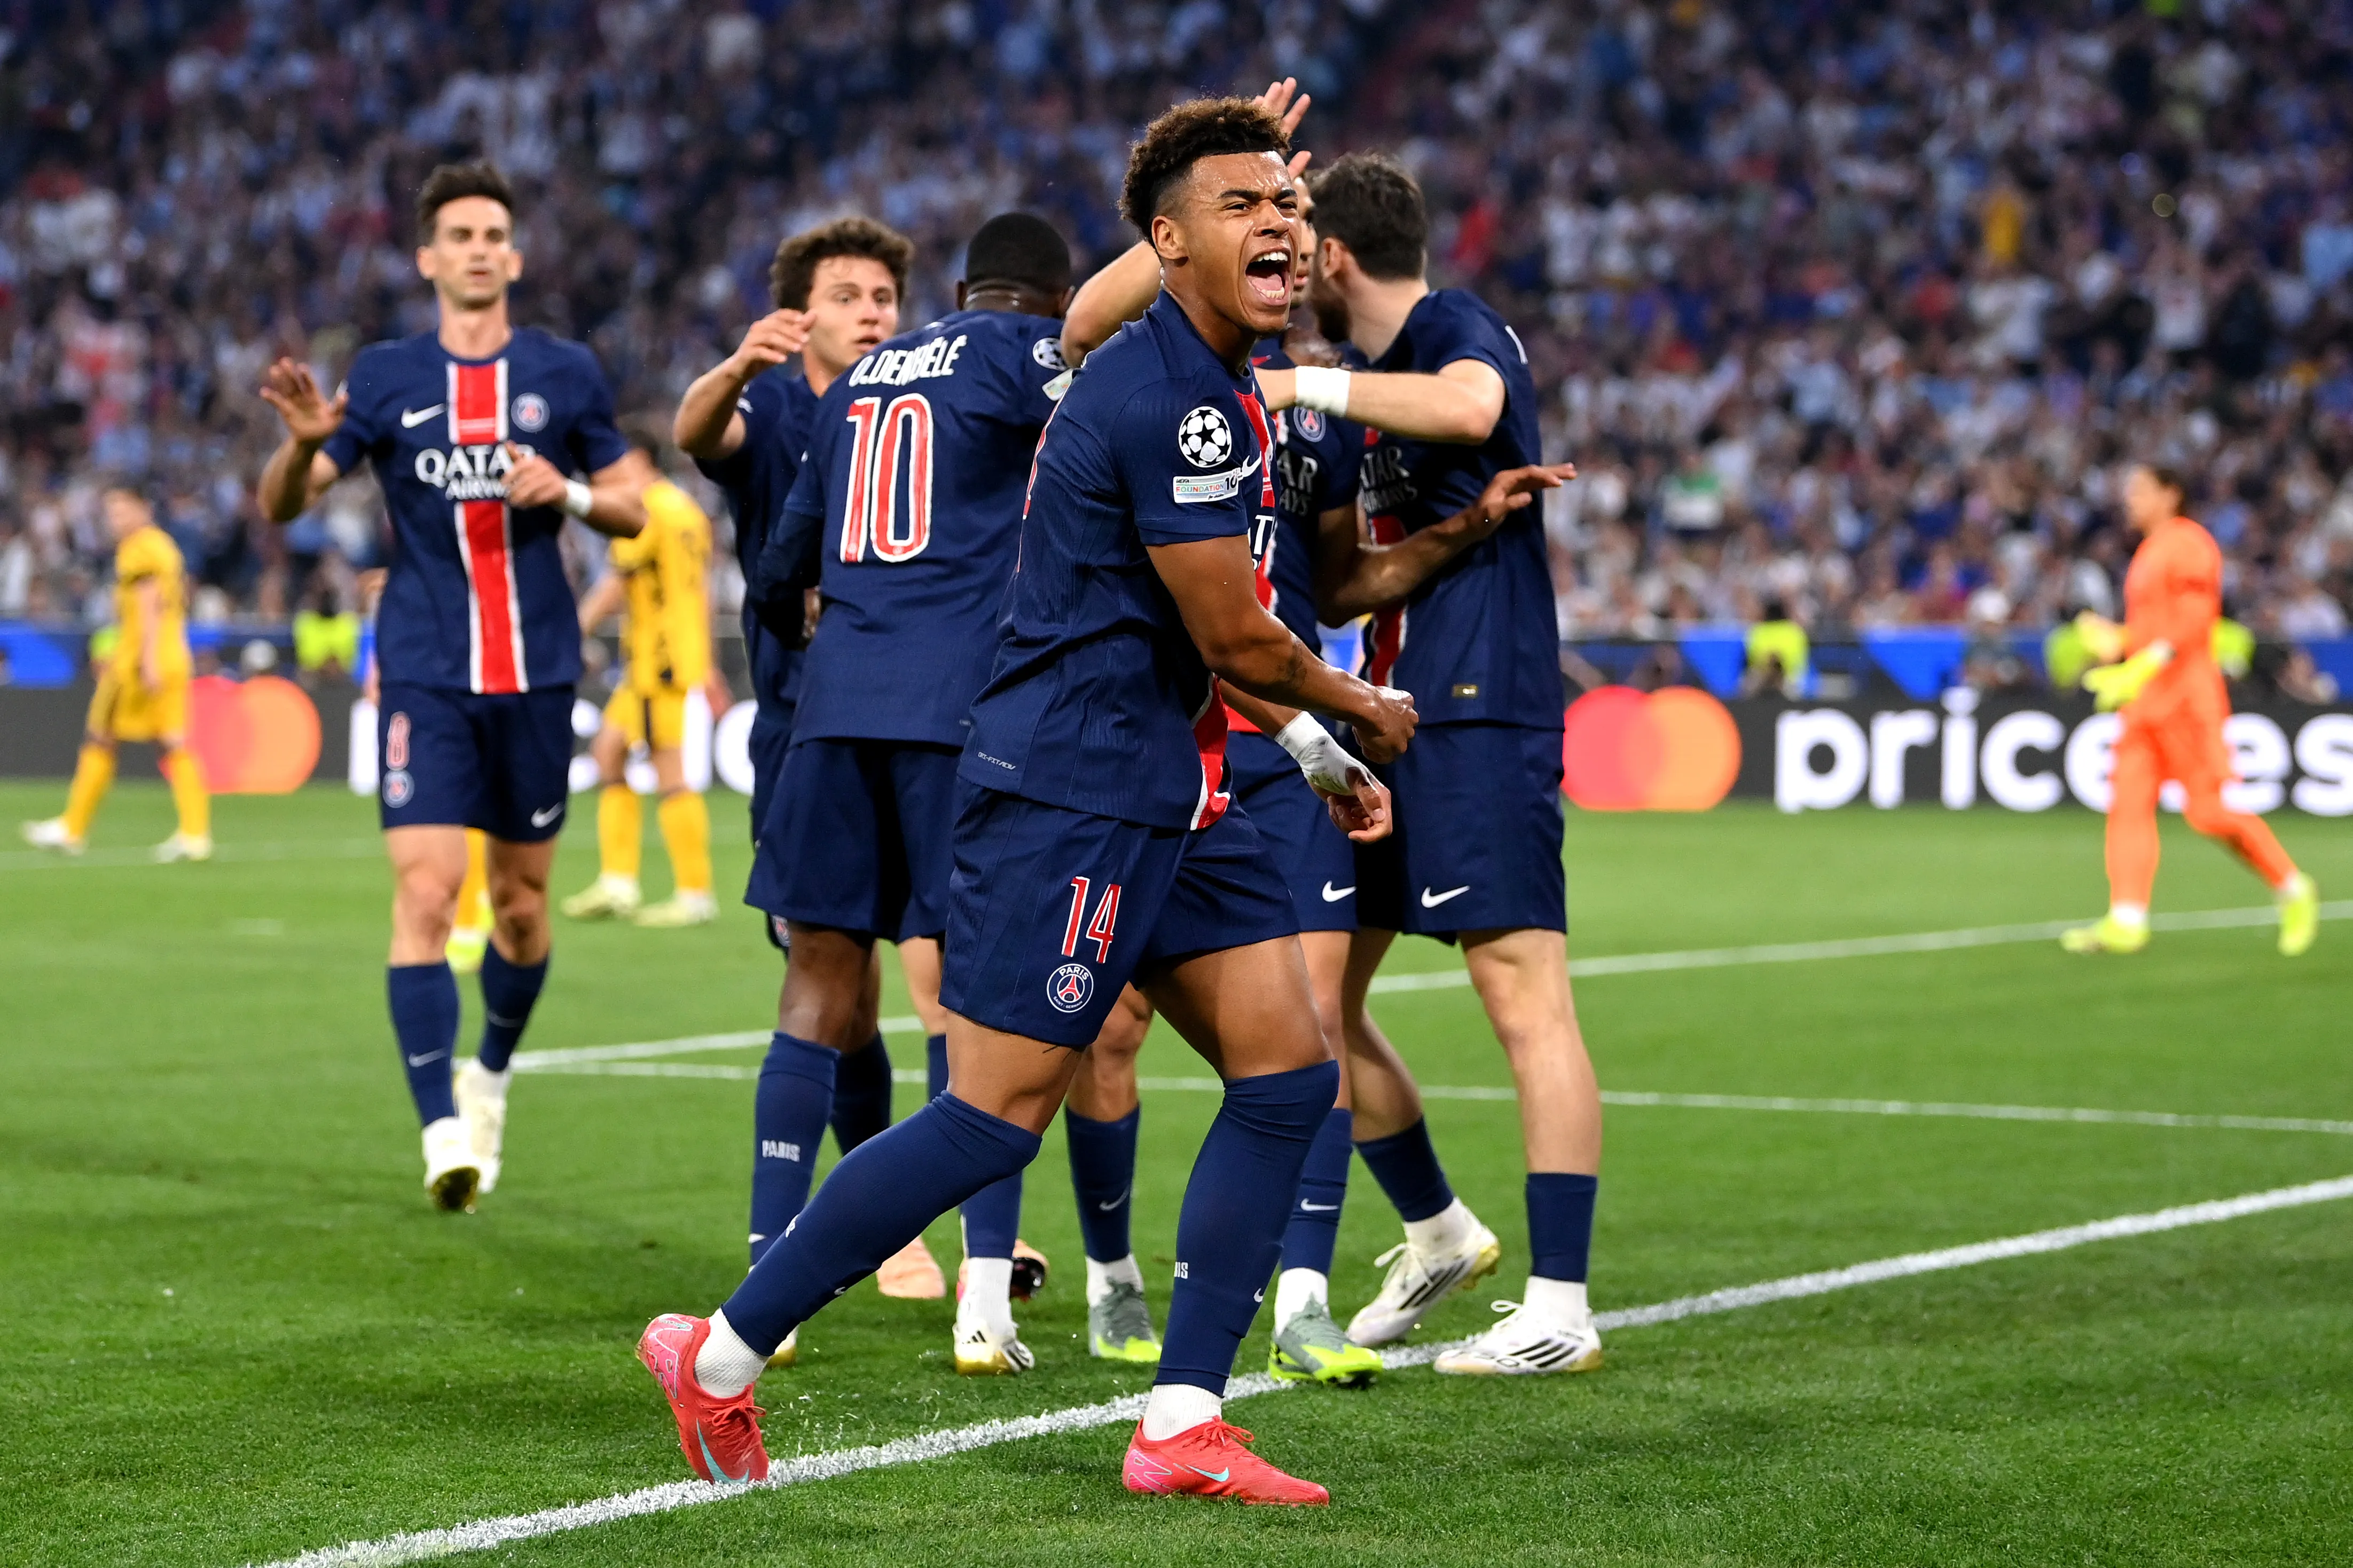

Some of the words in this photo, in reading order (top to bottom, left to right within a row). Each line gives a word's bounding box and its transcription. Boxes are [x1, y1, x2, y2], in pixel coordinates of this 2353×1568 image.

[414, 443, 536, 488] QATA
[840, 392, 934, 563] 10
[1176, 483, 1225, 493] FOUNDATION
[1775, 685, 2353, 816] pricees
[1062, 876, 1121, 963] 14
[1058, 966, 1089, 980] PARIS
[762, 1139, 801, 1162] PARIS
